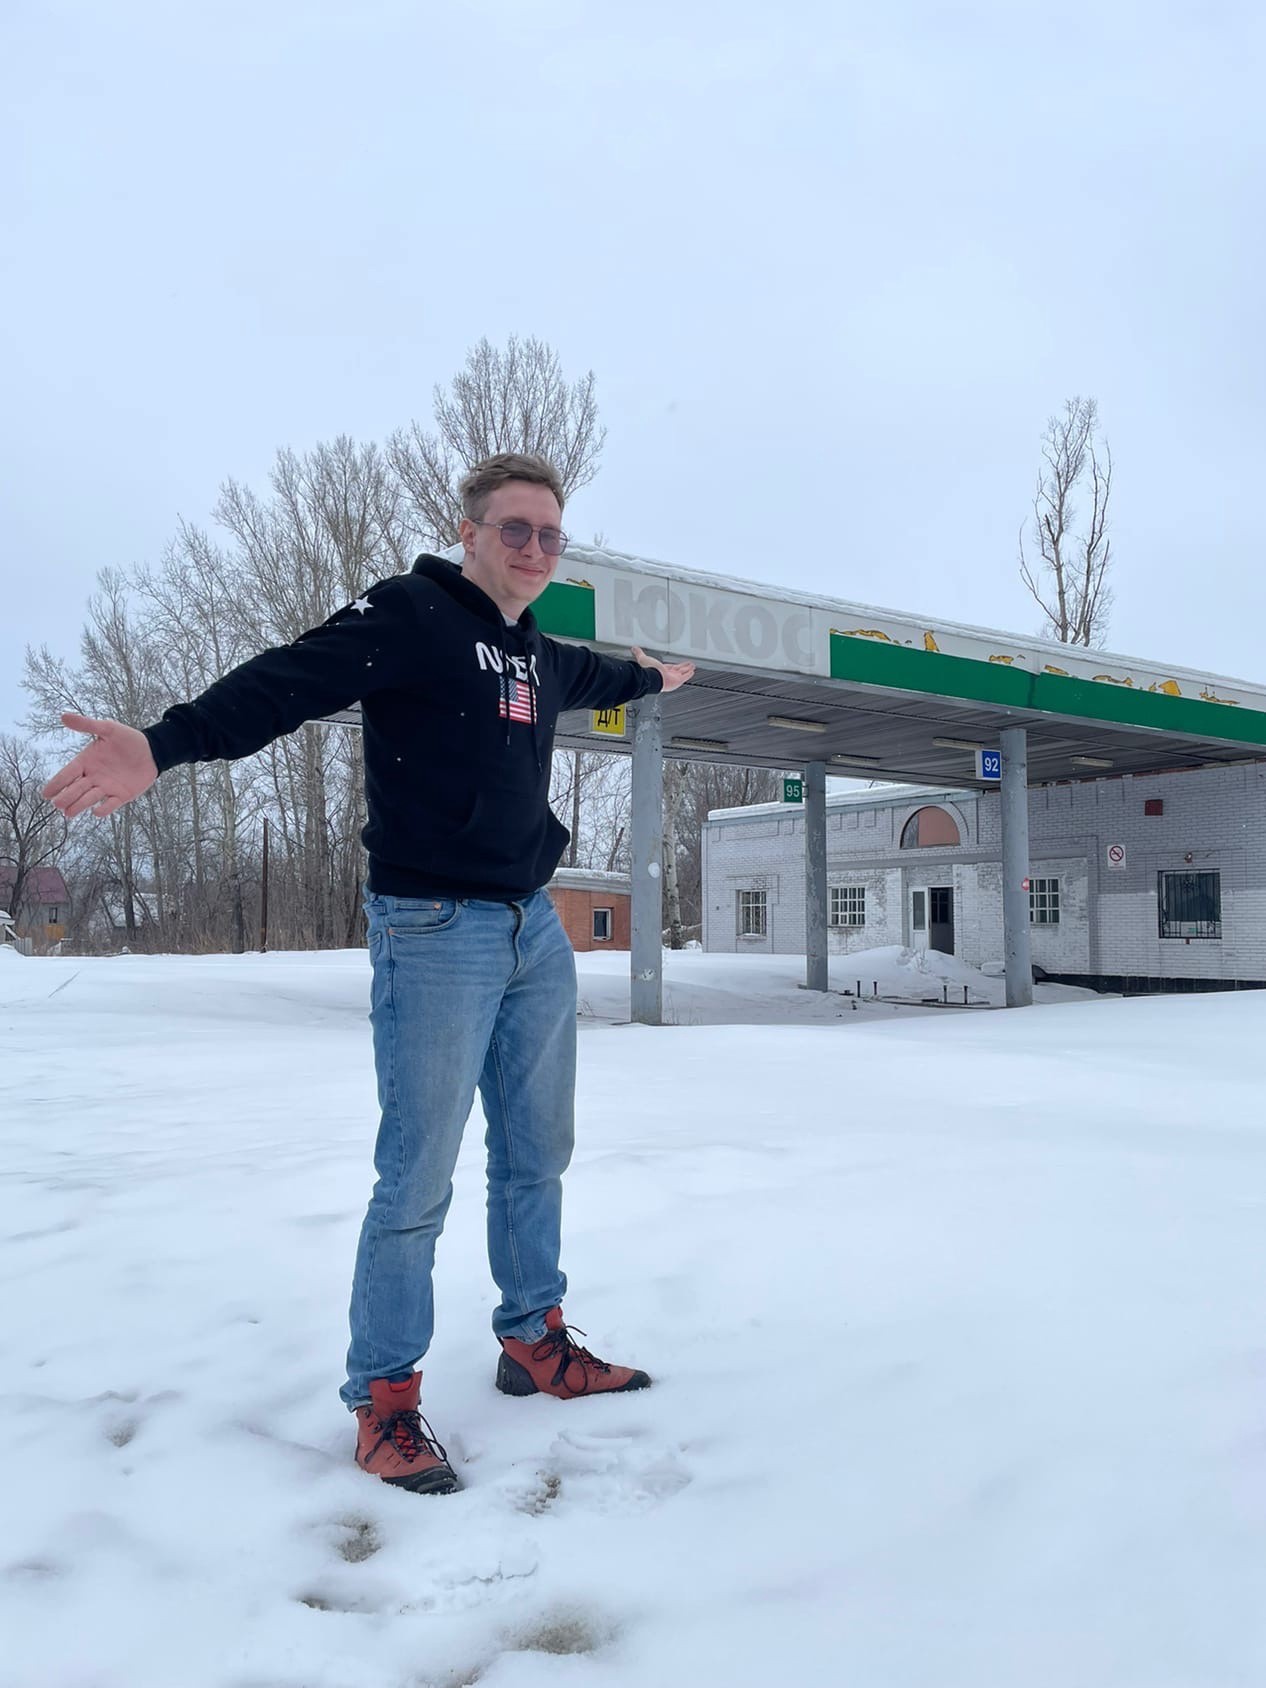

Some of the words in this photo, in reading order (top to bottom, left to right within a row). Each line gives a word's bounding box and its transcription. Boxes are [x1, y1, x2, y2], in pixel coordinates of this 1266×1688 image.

[614, 578, 815, 667] ЮКОС
[984, 756, 999, 772] 92
[786, 784, 800, 798] 95
